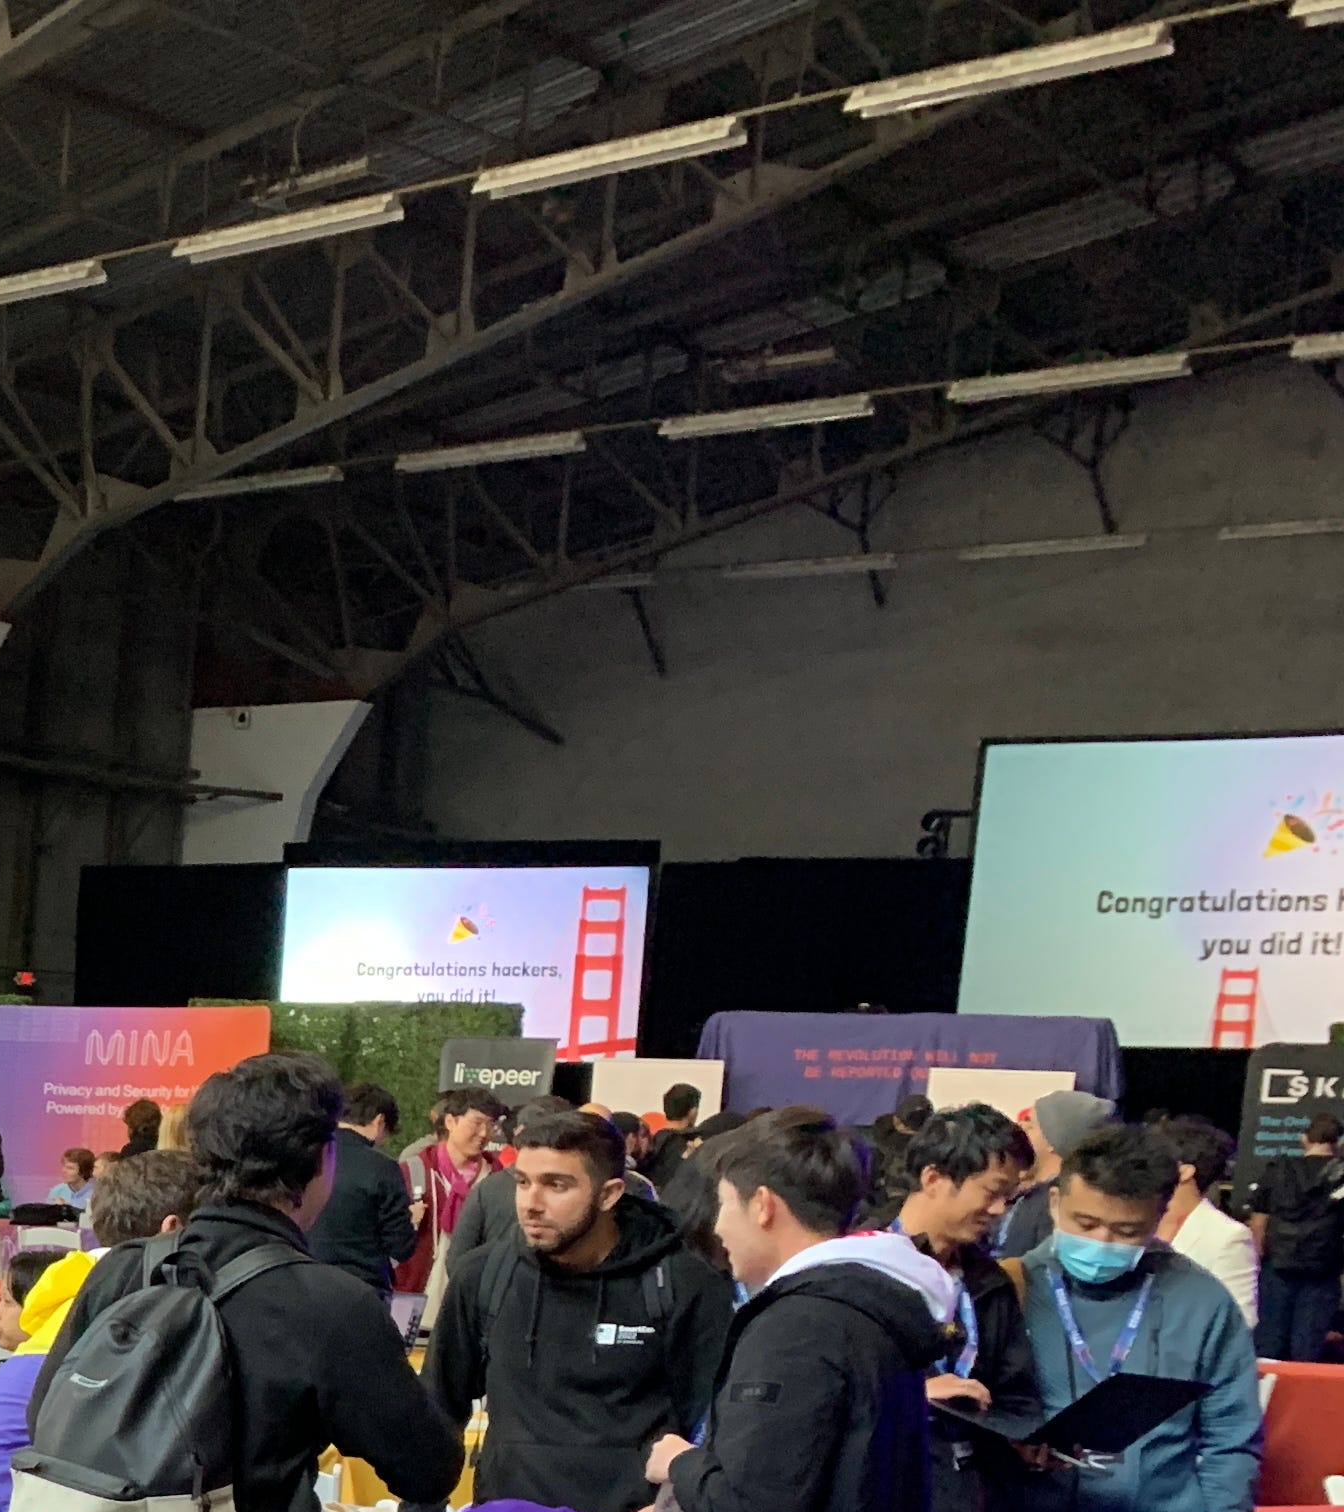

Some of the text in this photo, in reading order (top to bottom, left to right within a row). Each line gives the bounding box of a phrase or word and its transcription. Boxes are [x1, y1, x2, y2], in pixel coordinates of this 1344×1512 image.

[1097, 889, 1328, 919] Congratulations
[1199, 931, 1342, 960] you did it!
[357, 962, 563, 980] Congratulations hackers,
[85, 1029, 194, 1067] MINA
[794, 1049, 819, 1061] THE
[829, 1049, 915, 1062] REVOLUTION
[970, 1052, 997, 1064] NOT
[454, 1063, 541, 1089] livepeer
[804, 1067, 821, 1078] BE
[832, 1067, 902, 1079] REPORTED
[43, 1082, 91, 1098] Privacy
[95, 1084, 120, 1097] and
[123, 1085, 171, 1100] Security
[174, 1086, 190, 1098] for
[46, 1103, 124, 1118] Powered by
